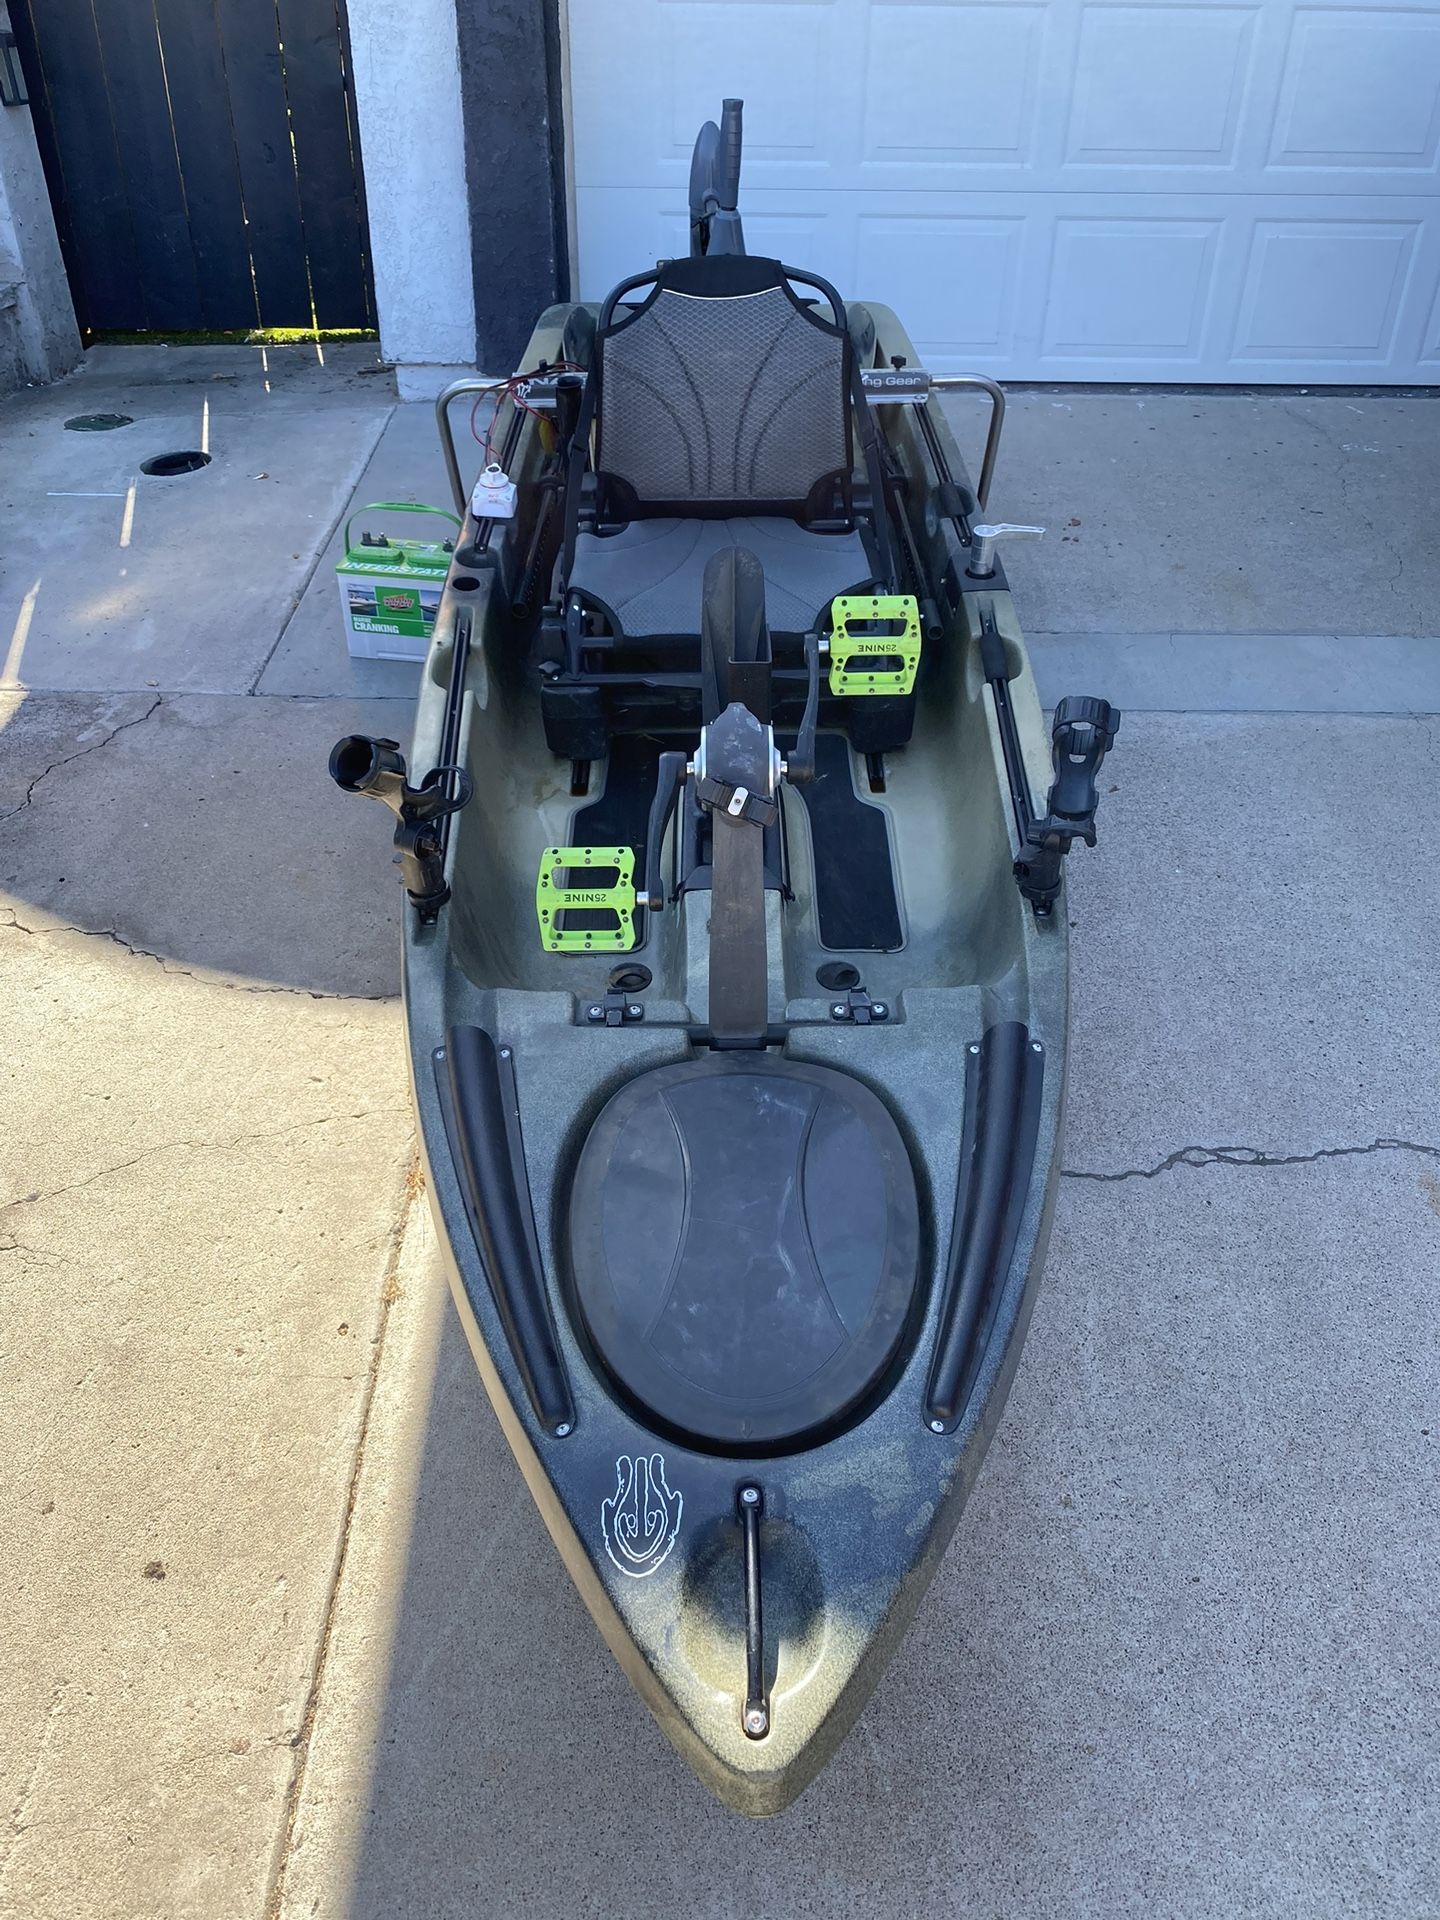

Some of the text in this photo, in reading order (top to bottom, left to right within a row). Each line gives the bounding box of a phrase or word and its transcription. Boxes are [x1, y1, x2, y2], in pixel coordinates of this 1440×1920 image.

[885, 376, 921, 386] Gear
[354, 622, 400, 634] CRANKING
[858, 644, 897, 653] 25NINE
[564, 893, 607, 903] 25NINE
